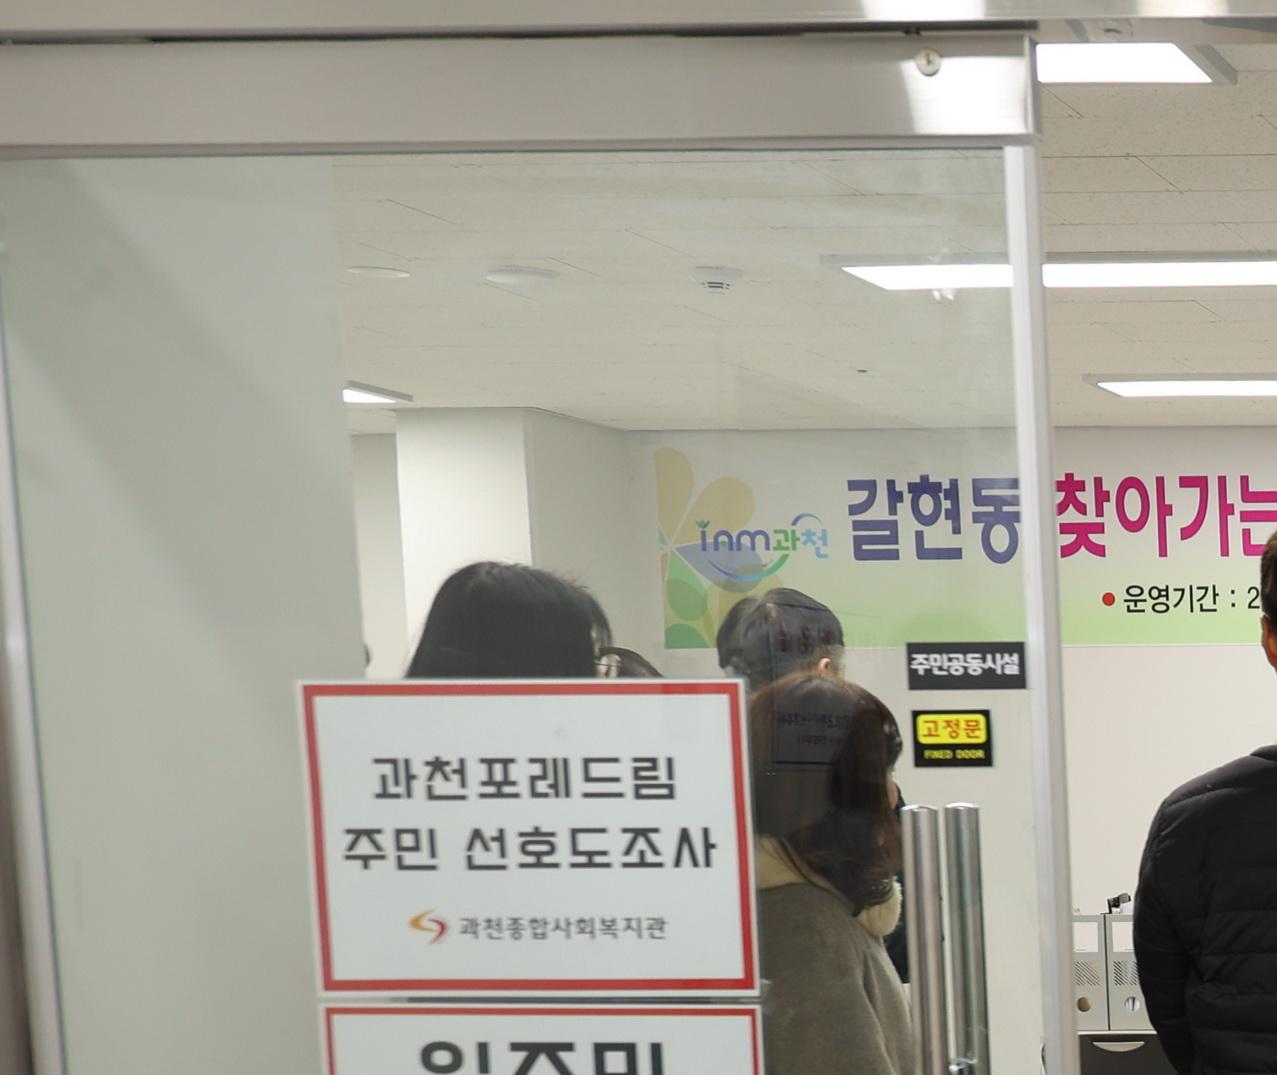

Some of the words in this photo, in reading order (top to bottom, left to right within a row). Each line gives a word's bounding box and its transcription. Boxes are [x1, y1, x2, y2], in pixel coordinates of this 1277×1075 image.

[847, 473, 1021, 564] 갈현동
[1123, 585, 1220, 614] 운영기간
[910, 653, 1020, 676] 주민공동시설
[922, 719, 982, 739] 고정문
[373, 756, 676, 801] 과천포레드림
[343, 828, 438, 871] 주민
[465, 826, 717, 871] 선호도조사
[459, 917, 669, 941] 과천종합사회복지관
